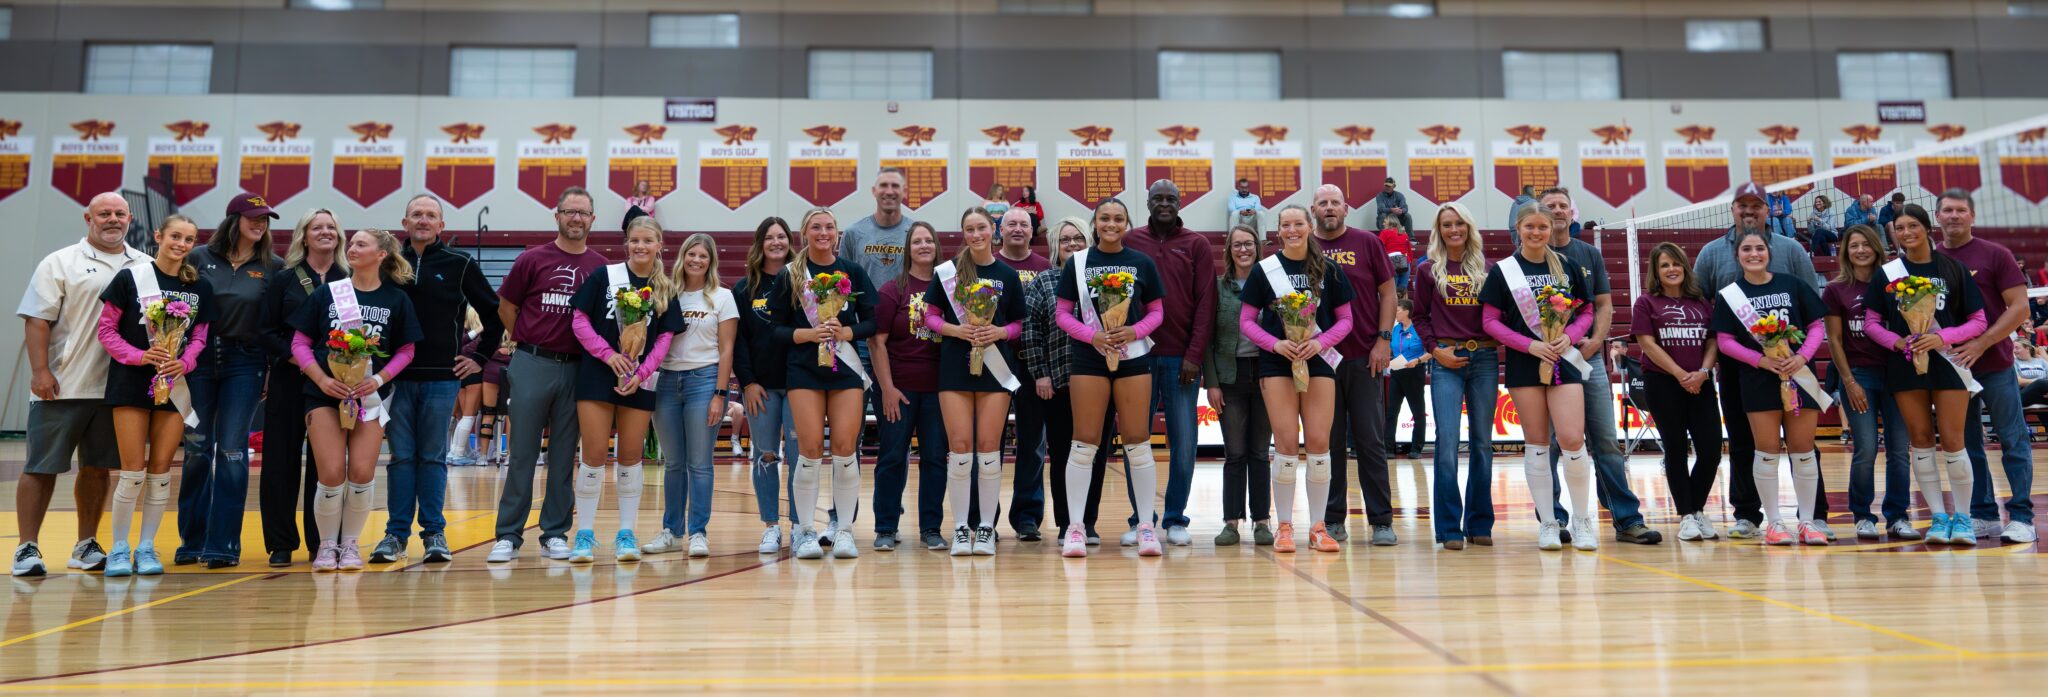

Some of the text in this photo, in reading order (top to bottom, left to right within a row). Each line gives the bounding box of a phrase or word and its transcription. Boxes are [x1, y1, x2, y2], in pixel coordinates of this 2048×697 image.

[667, 104, 714, 118] VISITORS
[1880, 105, 1924, 120] VISITORS
[61, 143, 119, 152] BOYS TENNIS
[155, 144, 214, 152] BOYS SOCCER
[250, 145, 277, 153] TRACK
[287, 145, 311, 153] FIELD
[354, 145, 393, 153] BOWLING
[443, 146, 489, 154] SWIMMING
[620, 147, 675, 155] BASKETBALL
[1842, 146, 1892, 155] BASKETBALL
[711, 148, 758, 156] BOYS GOLF
[801, 148, 846, 156] BOYS GOLF
[896, 149, 931, 157] BOYS XC
[985, 149, 1020, 157] BOYS XC
[1070, 149, 1114, 157] FOOTBALL
[1157, 148, 1200, 156] FOOTBALL
[1254, 148, 1281, 156] DANCE
[1322, 148, 1385, 156] CHEERLEADING
[1415, 148, 1466, 156] VOLLEYBALL
[1507, 148, 1532, 156] GIRLS
[1591, 148, 1613, 156] SWIM
[1446, 297, 1480, 305] HAWK
